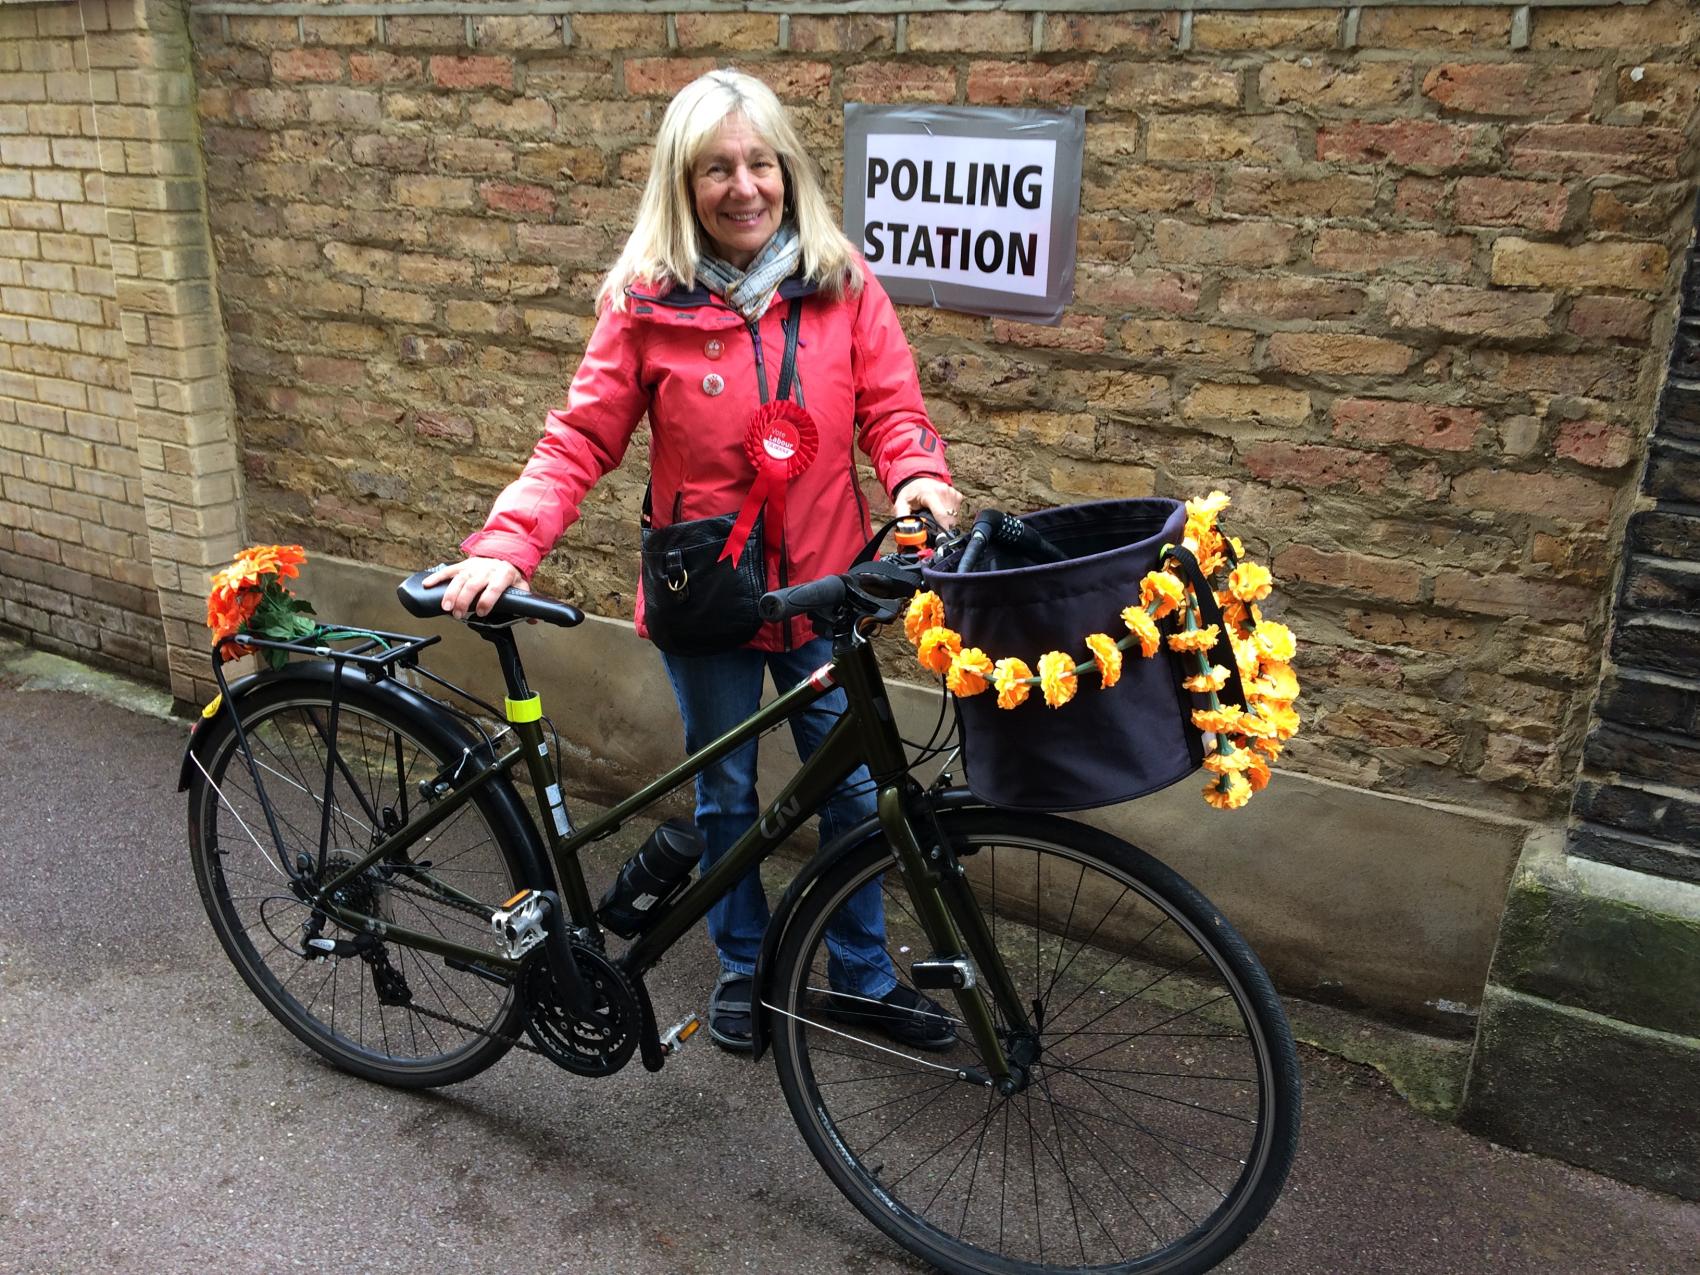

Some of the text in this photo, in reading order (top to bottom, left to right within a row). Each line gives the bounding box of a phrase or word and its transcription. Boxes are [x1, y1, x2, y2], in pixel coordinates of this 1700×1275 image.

[867, 157, 1043, 210] POLLING
[864, 220, 1038, 277] STATION
[768, 434, 794, 449] Labour
